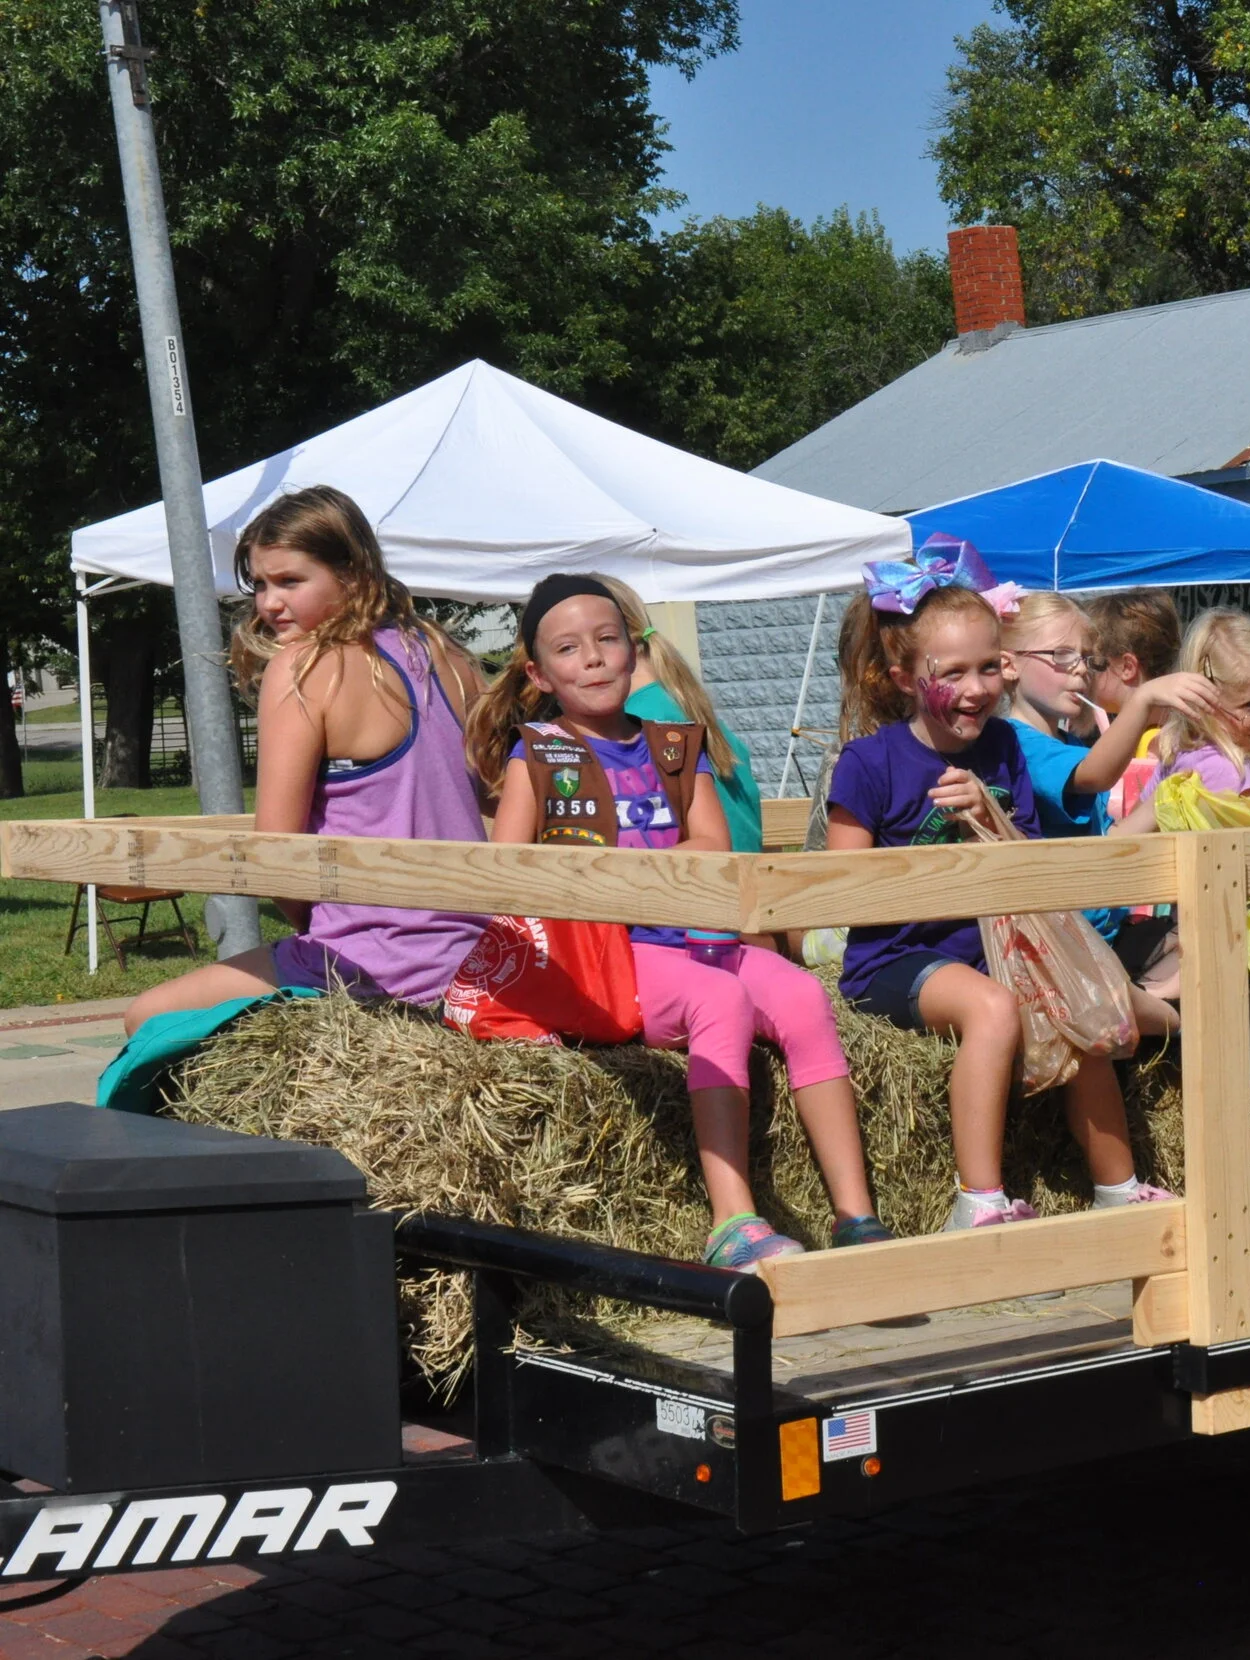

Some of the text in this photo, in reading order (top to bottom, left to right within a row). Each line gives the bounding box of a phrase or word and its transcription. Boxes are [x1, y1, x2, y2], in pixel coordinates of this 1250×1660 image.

[167, 338, 184, 413] B01354
[546, 799, 597, 816] 1356
[0, 1480, 399, 1577] AMAR
